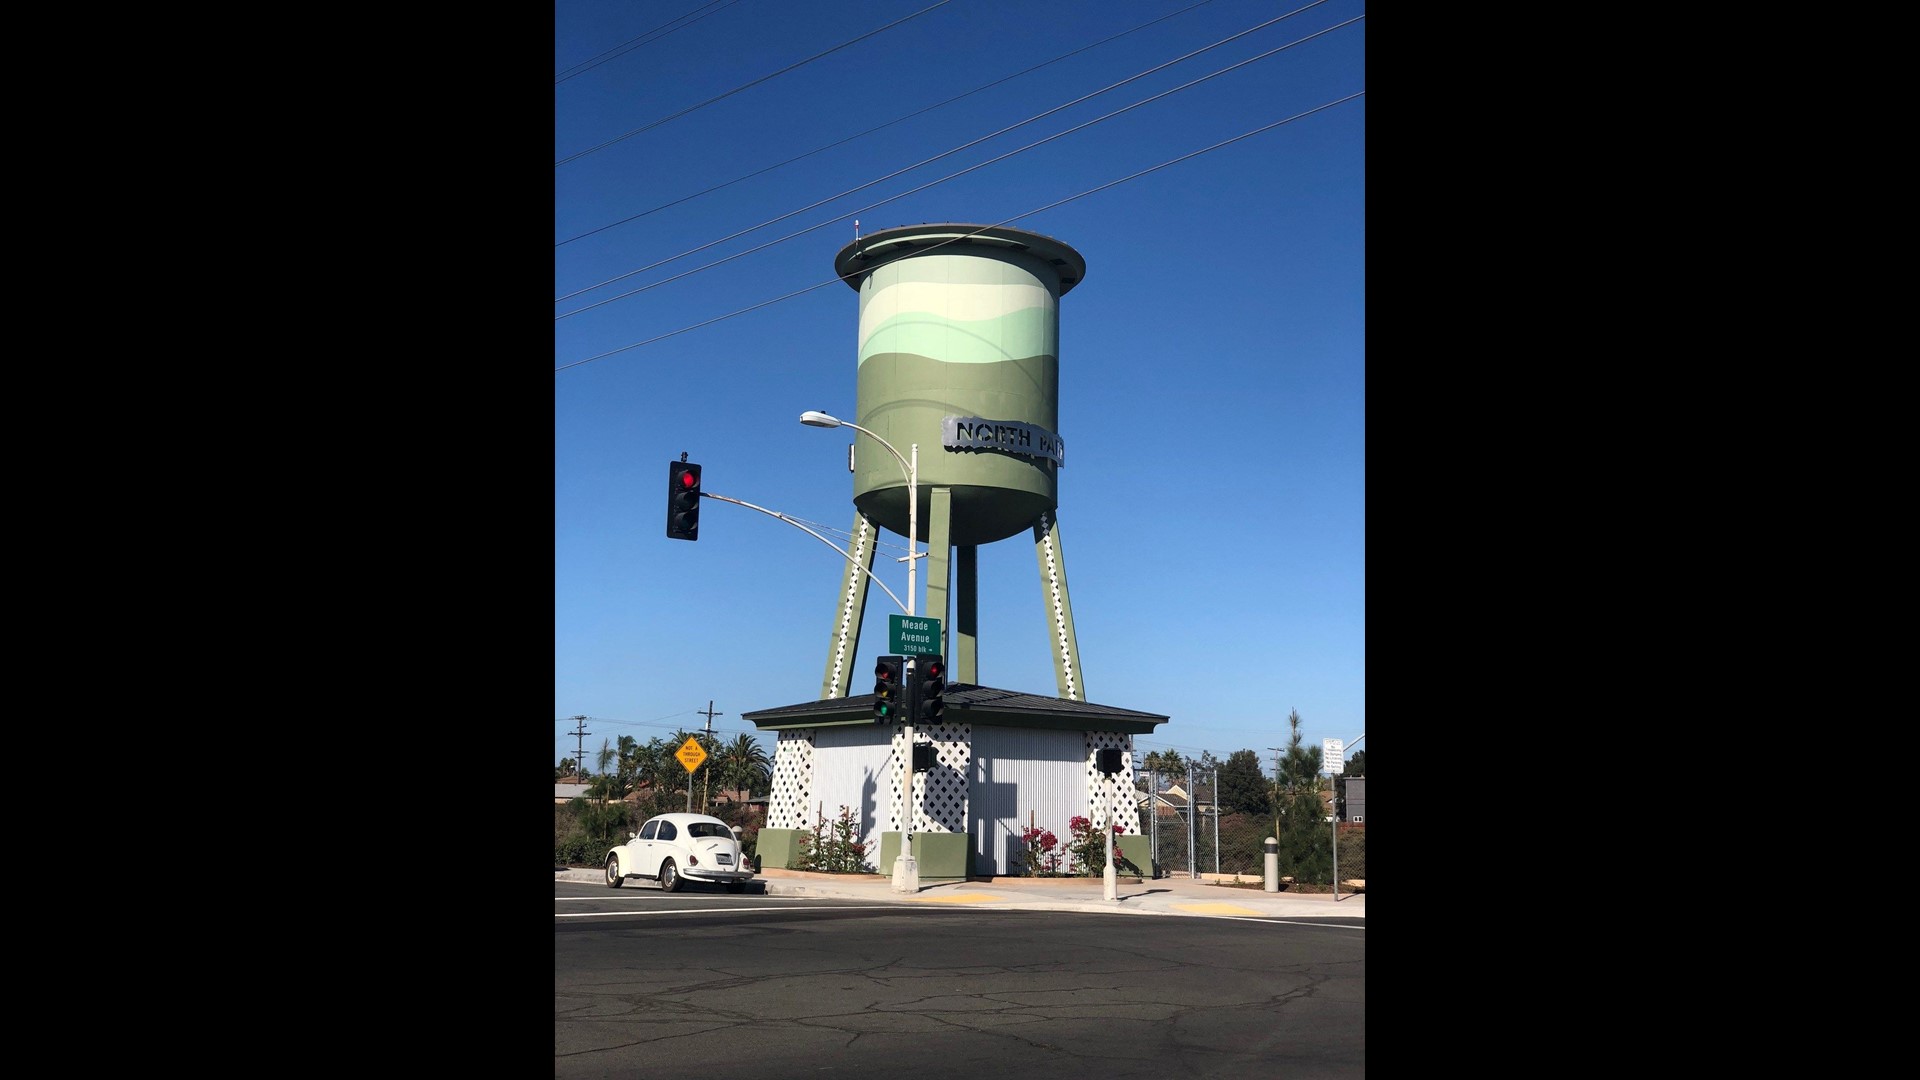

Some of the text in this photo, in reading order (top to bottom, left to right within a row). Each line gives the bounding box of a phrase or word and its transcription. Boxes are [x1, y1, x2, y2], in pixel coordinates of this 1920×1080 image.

[957, 422, 1031, 447] NORTH
[902, 619, 928, 631] Meade
[901, 631, 930, 643] Avenue
[903, 644, 927, 653] 3150 blk
